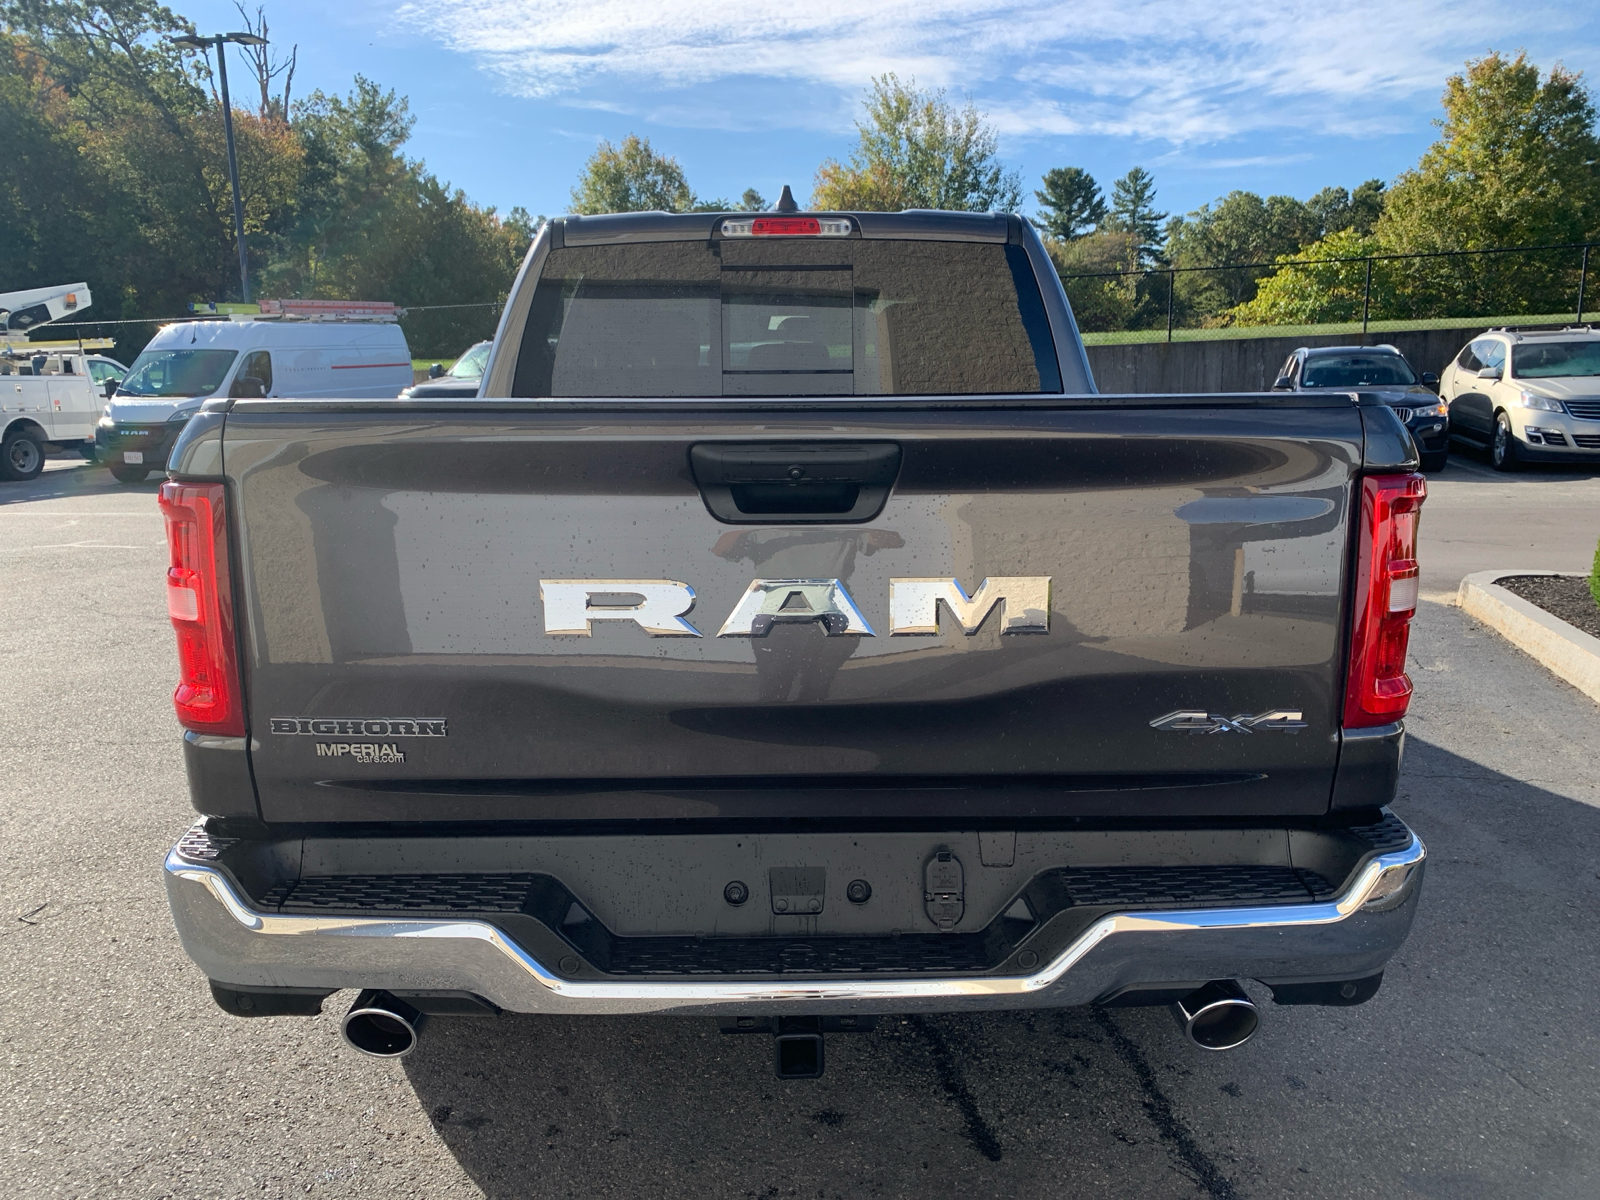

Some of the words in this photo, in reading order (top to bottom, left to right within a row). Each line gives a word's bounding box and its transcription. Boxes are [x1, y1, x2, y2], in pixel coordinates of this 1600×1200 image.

[539, 576, 1052, 638] RAM
[270, 717, 448, 737] BIGHORN
[316, 742, 404, 756] IMPERIAL
[356, 754, 405, 763] cars.com
